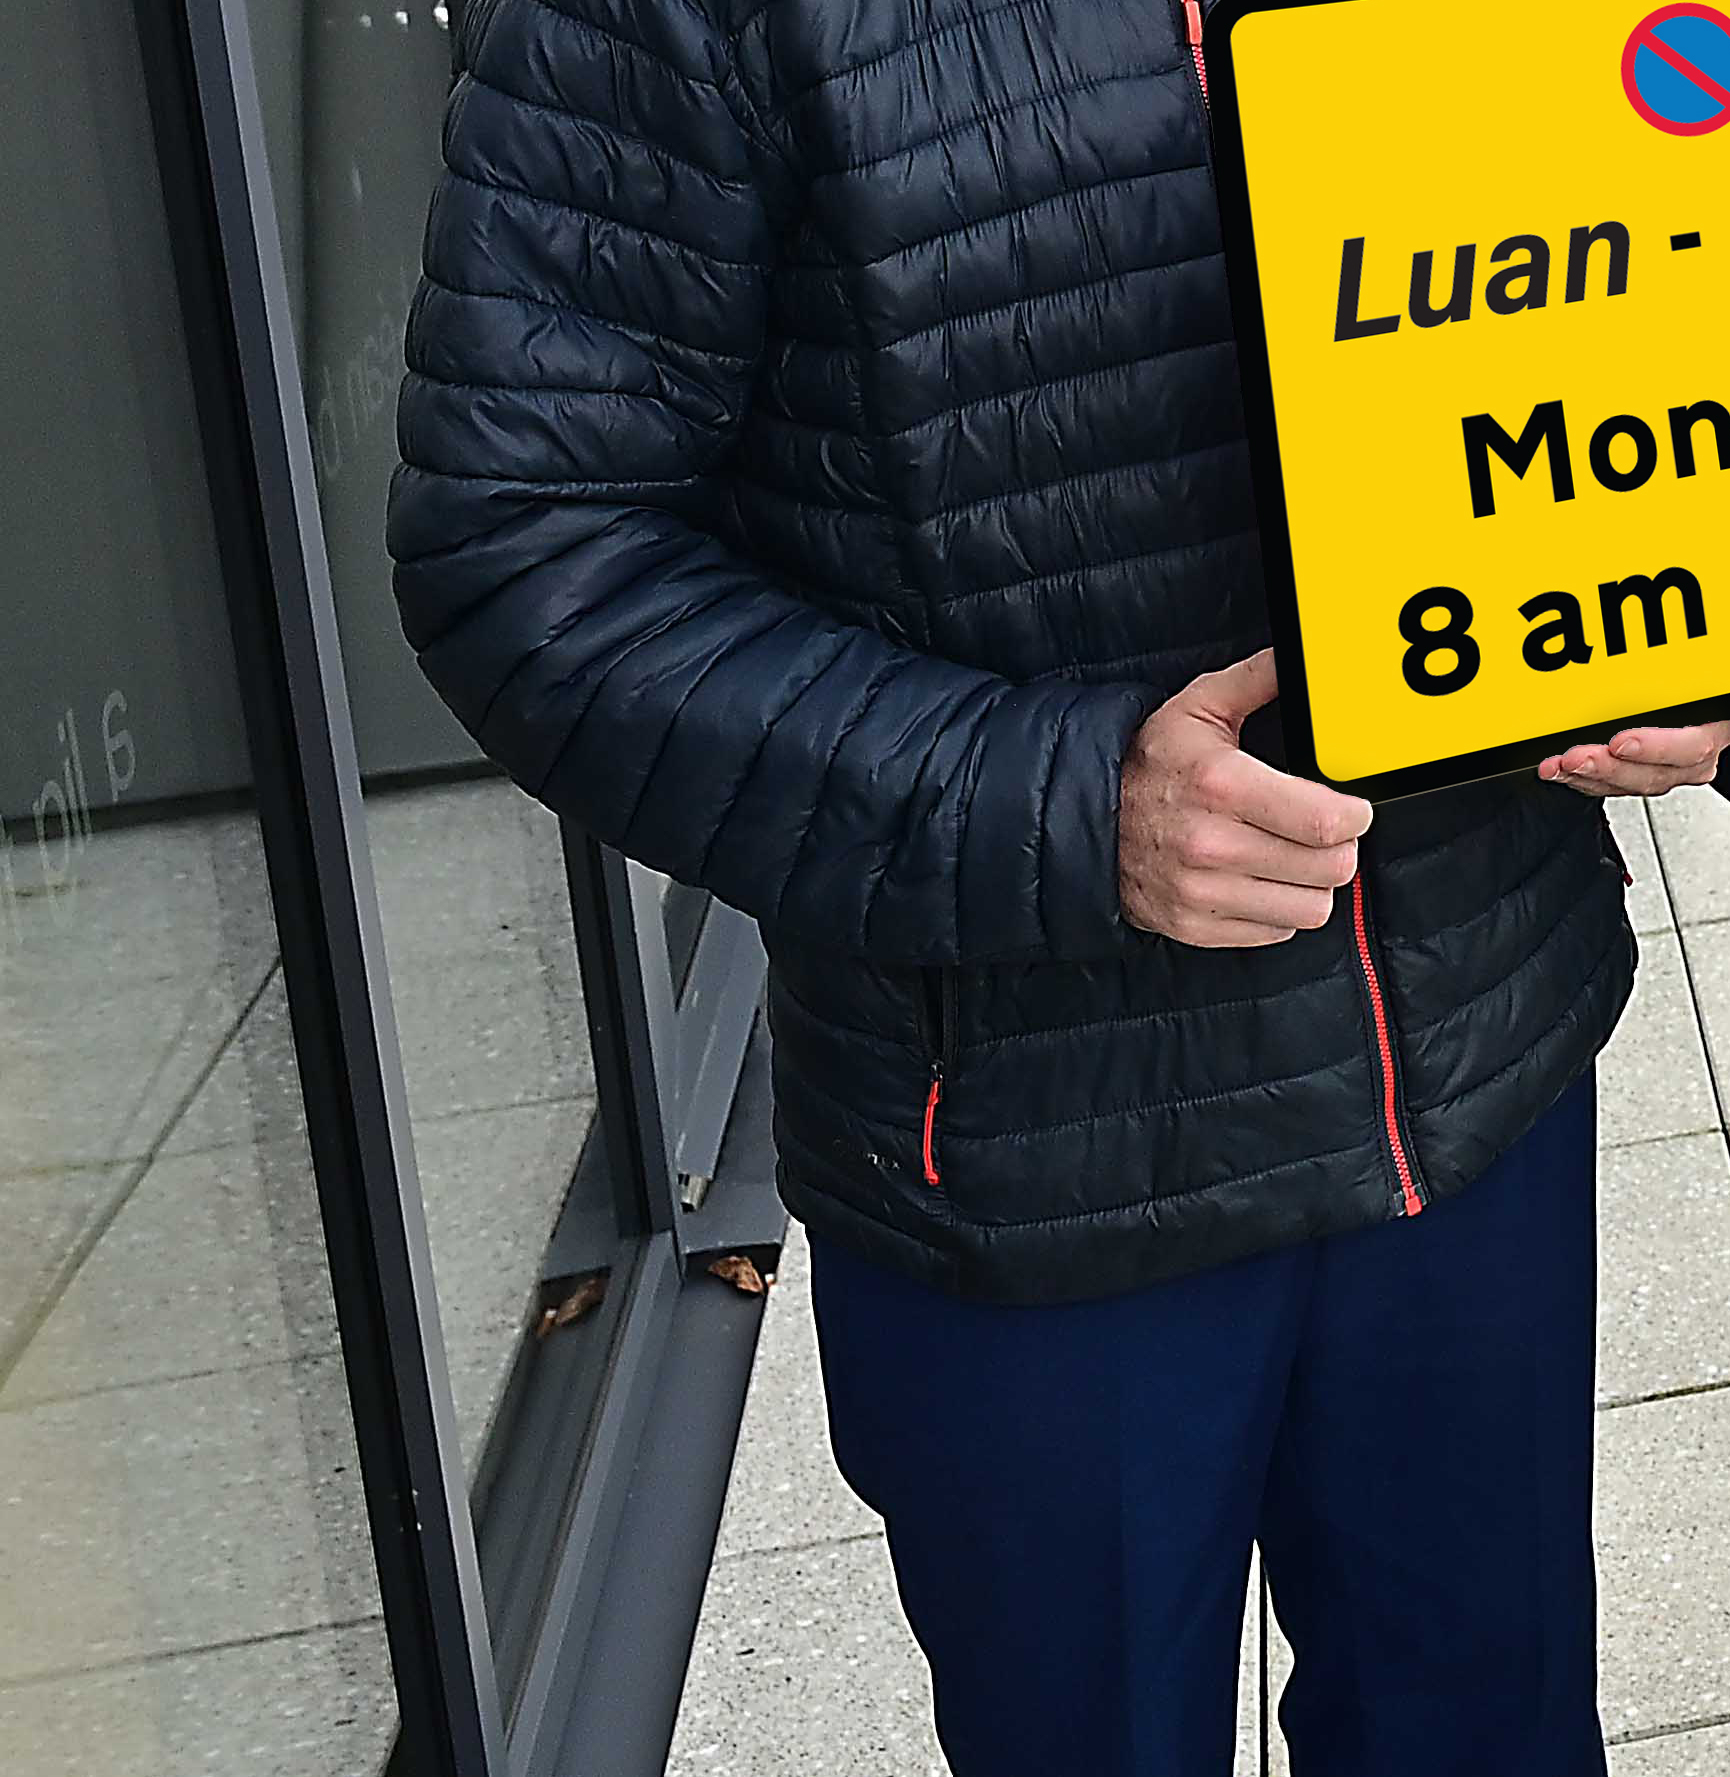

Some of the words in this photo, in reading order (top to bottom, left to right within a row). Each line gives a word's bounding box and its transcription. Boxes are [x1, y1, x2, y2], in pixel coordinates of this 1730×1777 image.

[1334, 221, 1629, 342] Luan
[1670, 232, 1701, 251] -
[1399, 587, 1480, 696] 8
[1518, 567, 1707, 672] am
